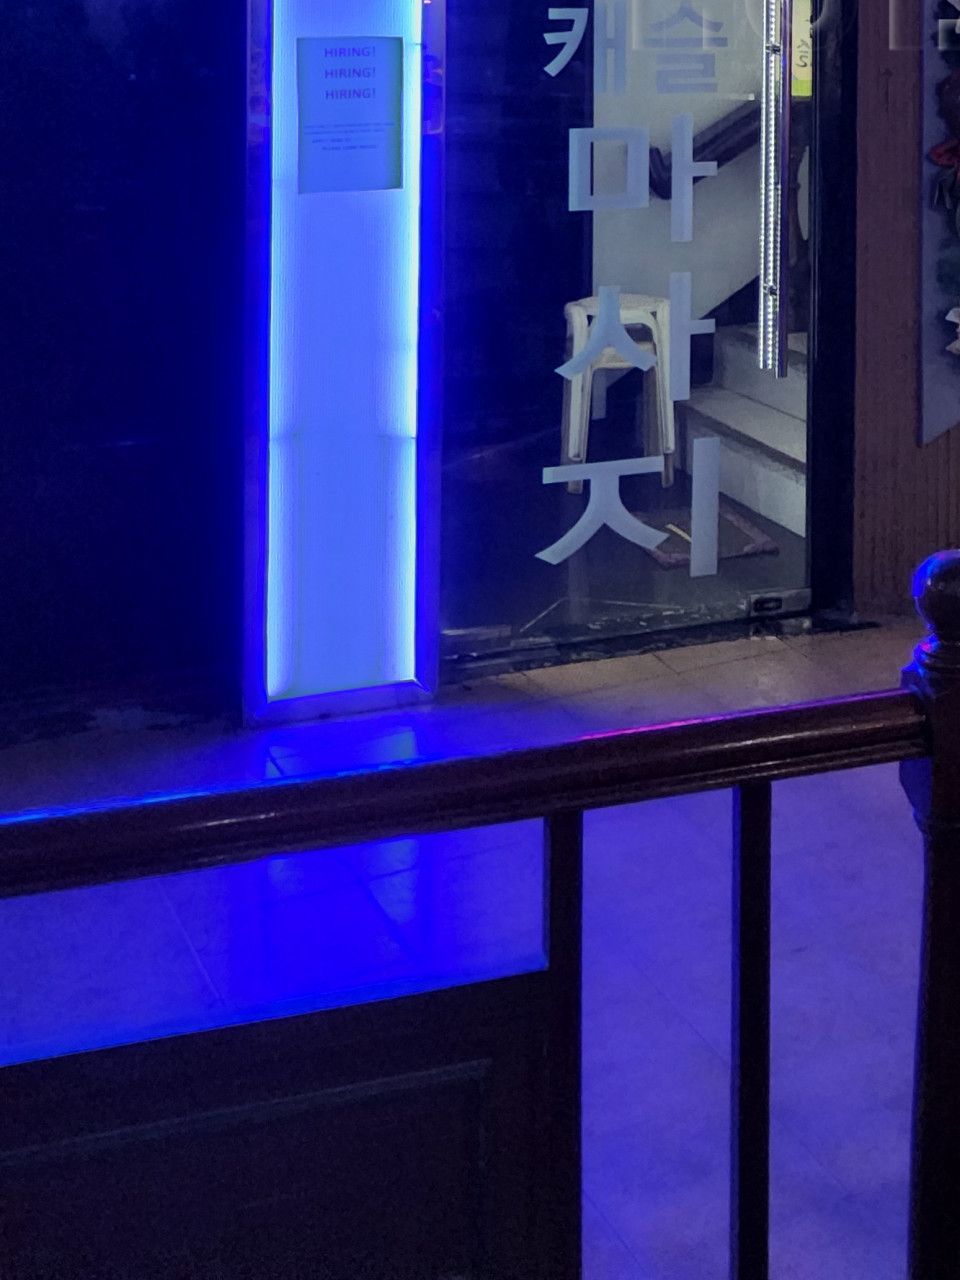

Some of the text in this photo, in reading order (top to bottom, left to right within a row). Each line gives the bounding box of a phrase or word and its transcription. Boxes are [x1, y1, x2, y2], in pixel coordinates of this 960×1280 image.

[324, 46, 376, 58] HIRING!
[543, 0, 728, 96] 캐슬
[324, 68, 376, 79] HIRING!
[325, 88, 376, 100] HIRING!
[534, 113, 721, 579] 마사지
